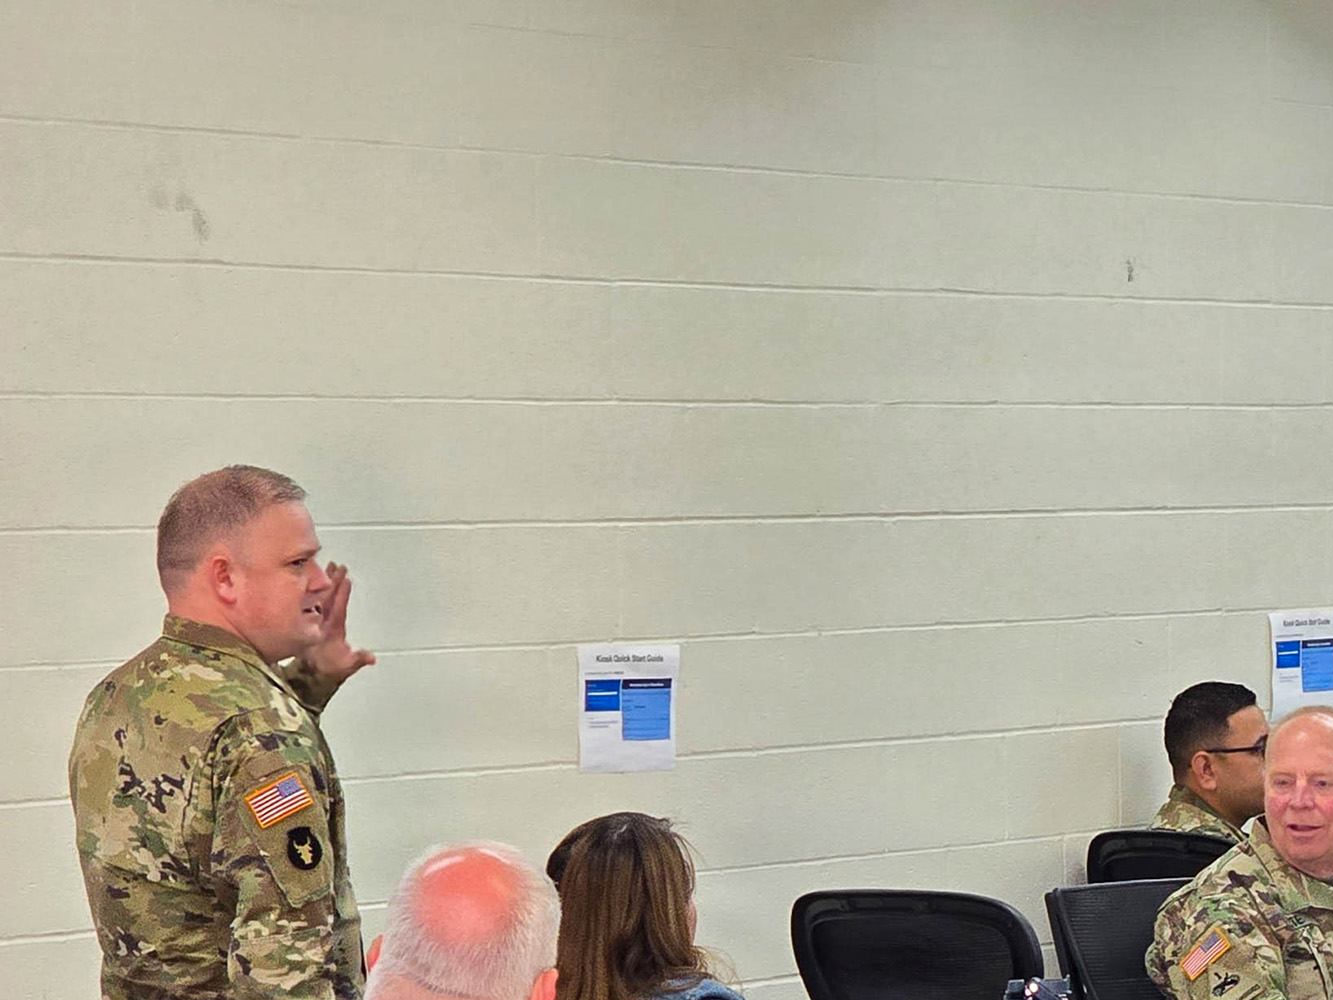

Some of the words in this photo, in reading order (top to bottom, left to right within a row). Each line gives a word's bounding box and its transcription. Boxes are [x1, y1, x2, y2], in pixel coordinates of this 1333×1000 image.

[613, 654, 630, 663] Quick
[631, 654, 646, 663] Start
[647, 654, 664, 663] Guide
